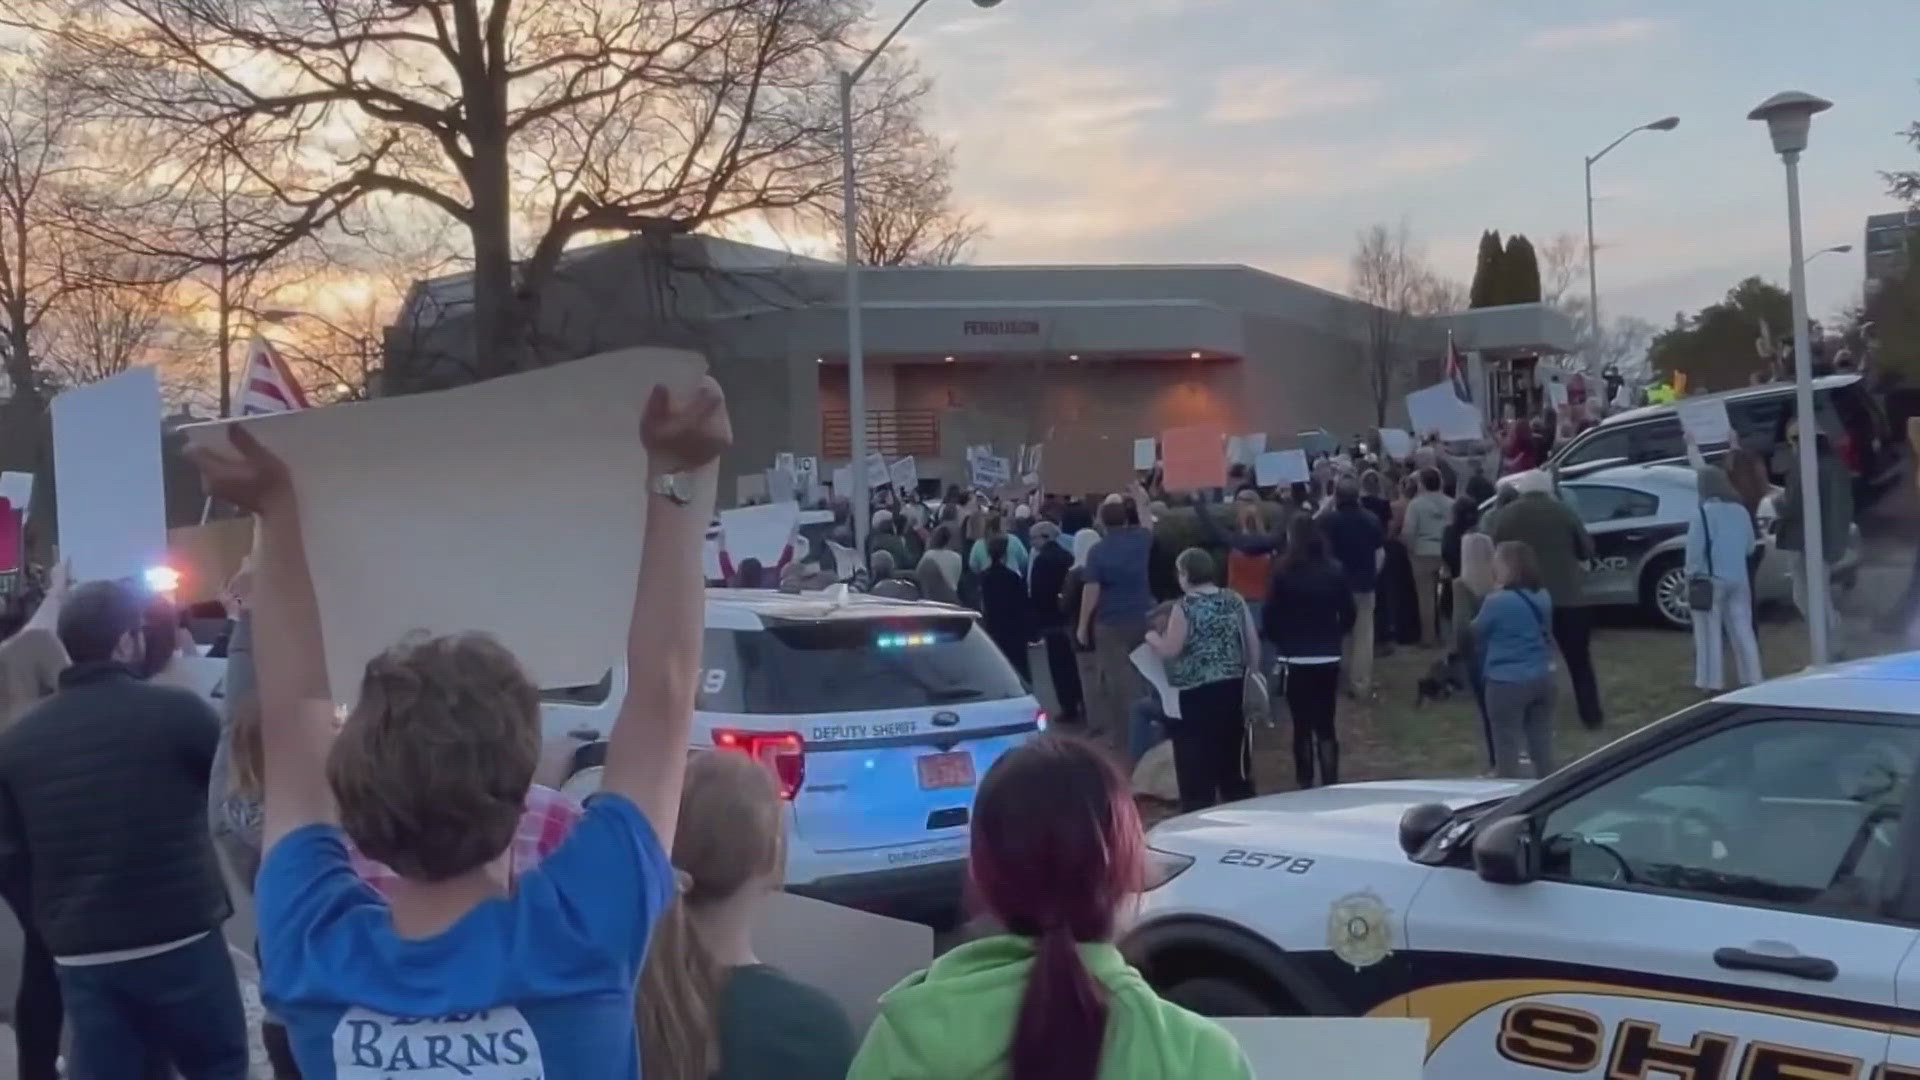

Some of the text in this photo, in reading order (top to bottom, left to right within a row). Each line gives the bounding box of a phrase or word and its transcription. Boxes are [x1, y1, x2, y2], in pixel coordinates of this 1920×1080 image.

[812, 720, 917, 740] DEPUTY SHERIFF
[1219, 849, 1315, 874] 2578
[346, 1019, 529, 1075] BARNS
